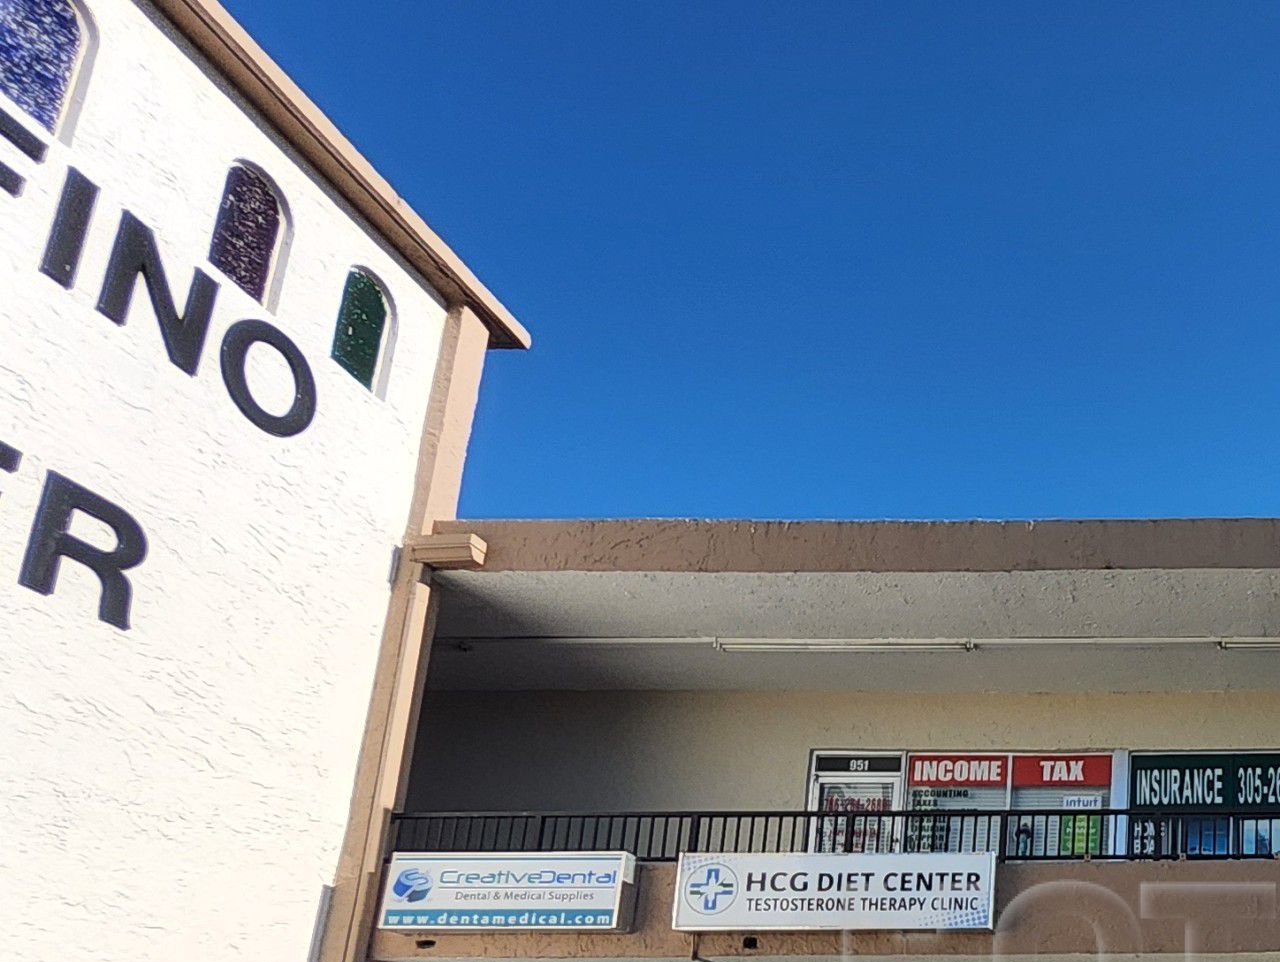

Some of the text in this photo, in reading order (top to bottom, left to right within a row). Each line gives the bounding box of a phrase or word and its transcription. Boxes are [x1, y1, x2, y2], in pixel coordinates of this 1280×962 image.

[0, 441, 149, 631] R
[913, 759, 1085, 782] INCOME TAX
[912, 789, 969, 798] ACCOUNTING
[1136, 767, 1224, 805] INSURANCE
[439, 869, 617, 885] CreativeDental
[746, 872, 982, 892] HCG DIET CENTER
[454, 890, 595, 902] Dental & Medical Supplies
[746, 897, 979, 912] TESTOSTERONE THERAPY CLINIC
[387, 911, 611, 926] www.dentamedical.com
